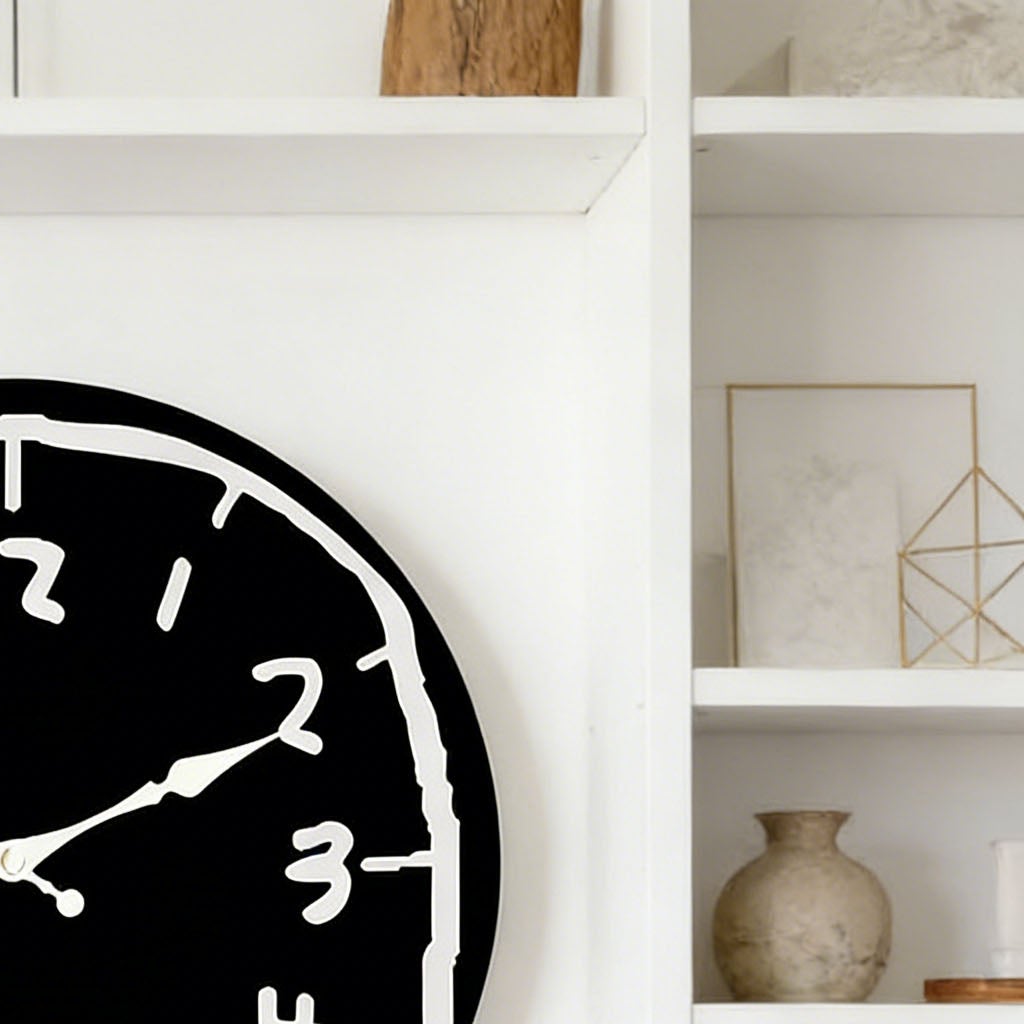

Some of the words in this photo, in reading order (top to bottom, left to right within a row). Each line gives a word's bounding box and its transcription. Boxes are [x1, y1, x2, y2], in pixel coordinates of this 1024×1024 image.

[157, 557, 193, 632] 1
[252, 656, 323, 755] 2
[285, 821, 354, 925] 3
